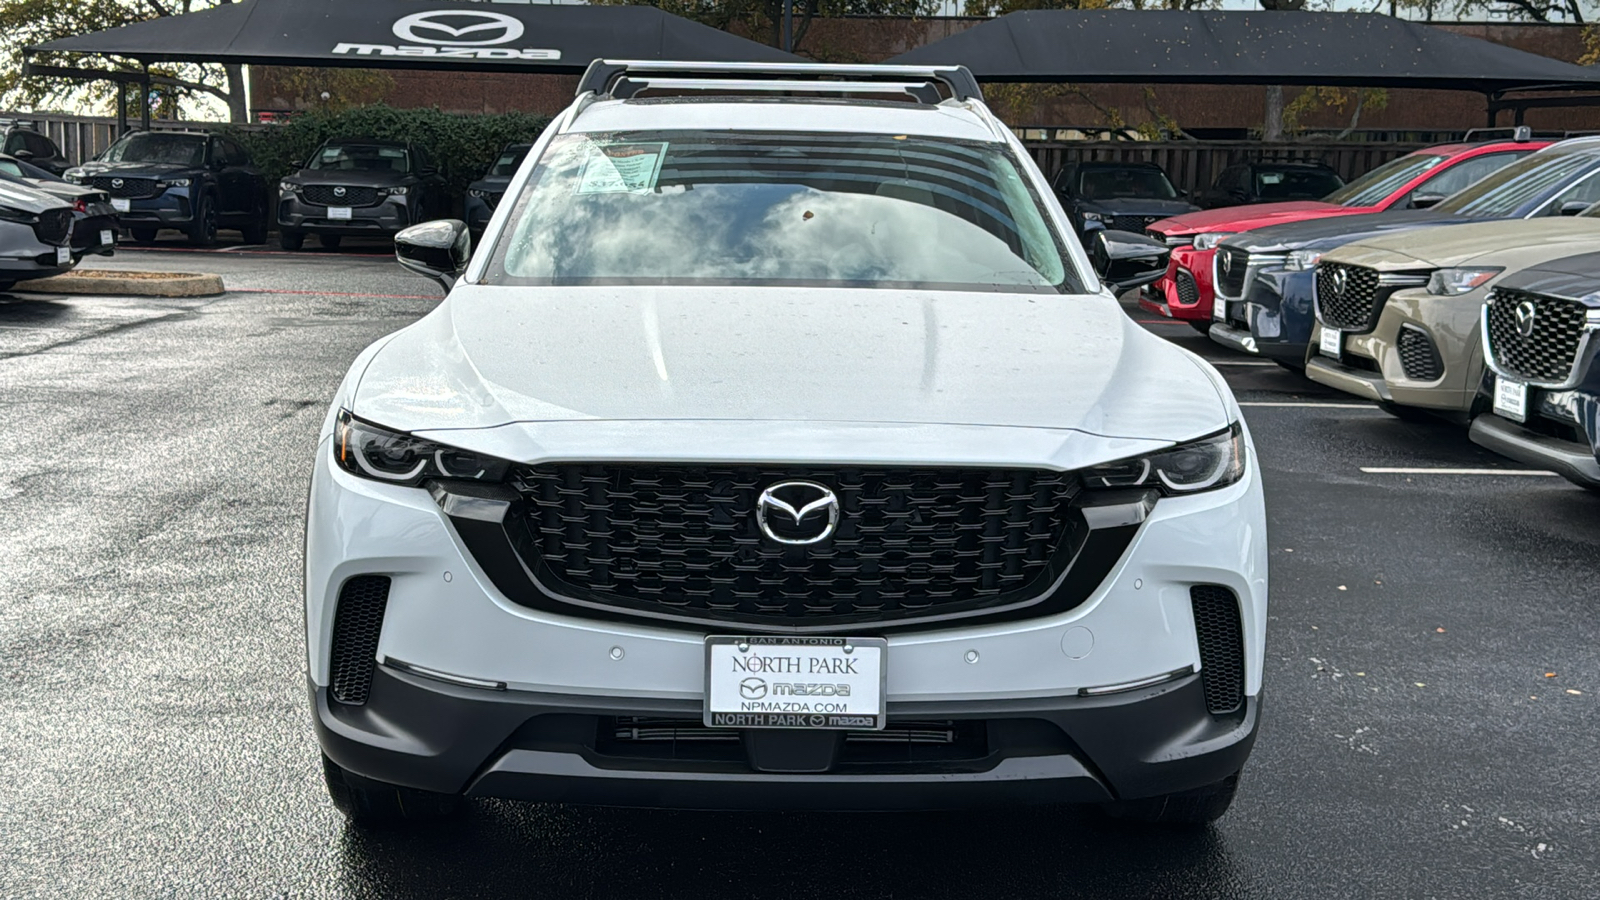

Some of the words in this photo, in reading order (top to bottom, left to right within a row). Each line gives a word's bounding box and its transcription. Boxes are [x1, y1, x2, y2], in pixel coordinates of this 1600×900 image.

[332, 42, 561, 60] mazda
[749, 637, 777, 645] SAN
[781, 638, 843, 646] ANTONIO
[731, 655, 801, 674] NORTH
[808, 656, 859, 675] PARK
[772, 682, 851, 697] mazda
[740, 701, 848, 713] NPMAZDA.COM
[715, 713, 765, 726] NORTH
[768, 714, 807, 726] PARK
[828, 715, 874, 726] mazda
